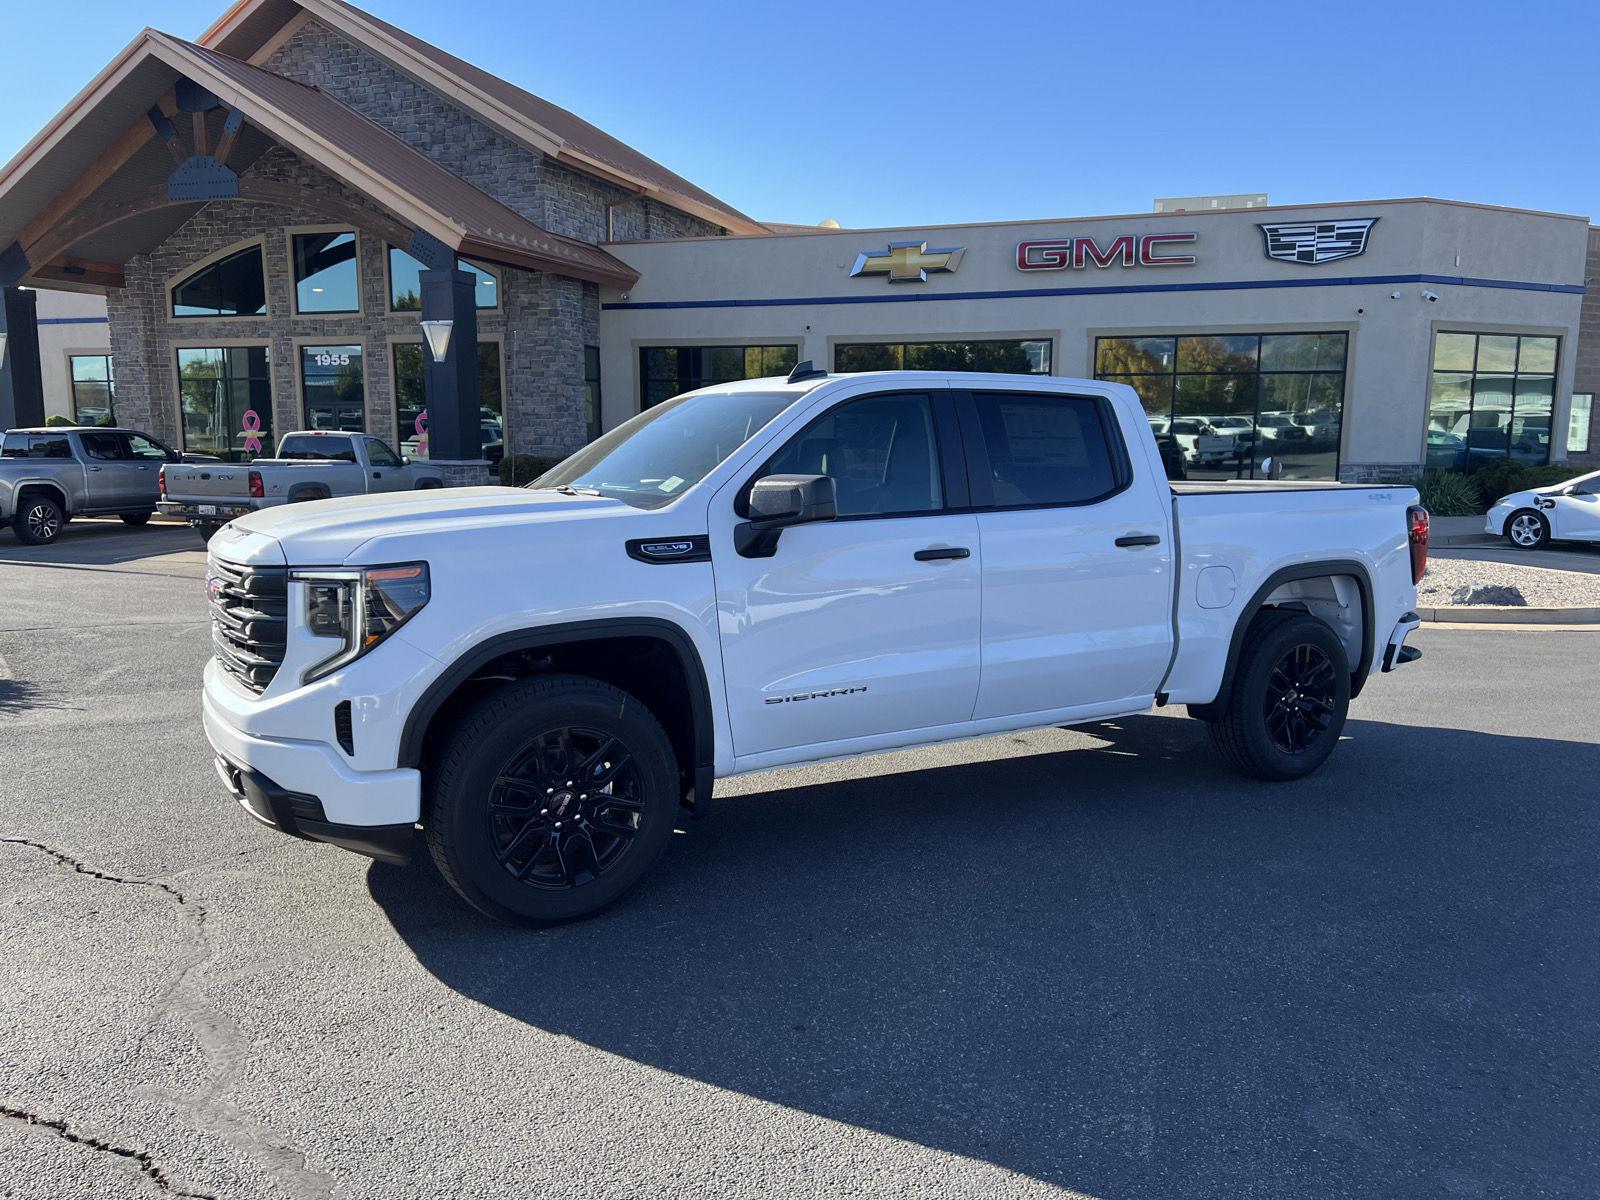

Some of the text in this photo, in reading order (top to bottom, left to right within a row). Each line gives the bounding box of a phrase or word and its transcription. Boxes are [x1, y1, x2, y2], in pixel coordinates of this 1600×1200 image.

[1015, 233, 1198, 271] GMC
[314, 354, 350, 366] 1955
[764, 685, 868, 705] SIERRA
